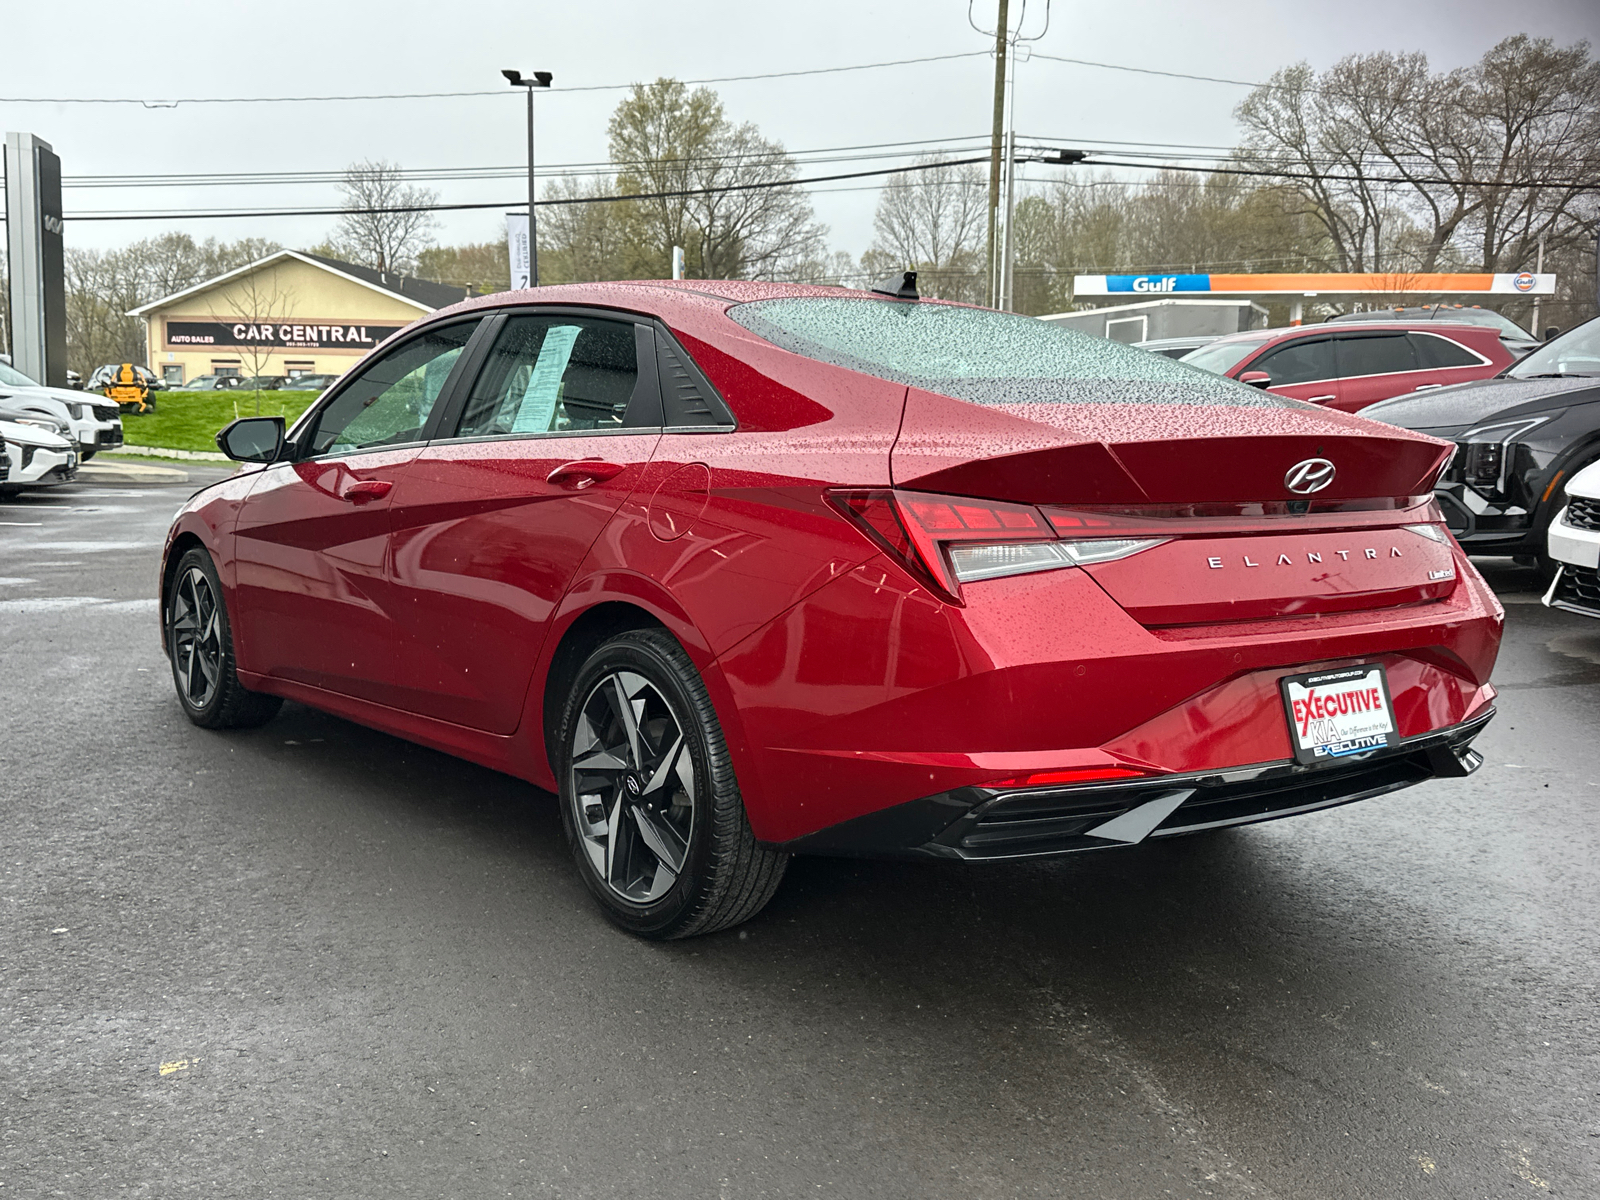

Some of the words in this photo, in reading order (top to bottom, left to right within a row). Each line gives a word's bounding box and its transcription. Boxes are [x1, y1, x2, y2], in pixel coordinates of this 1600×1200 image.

[1132, 277, 1177, 292] Gulf
[191, 336, 214, 344] SALES
[232, 324, 274, 341] CAR
[278, 324, 373, 342] CENTRAL
[1207, 546, 1402, 569] ELANTRA
[1428, 568, 1454, 580] Limited
[560, 684, 578, 742] KUMHO
[1292, 687, 1382, 739] EXECUTIVE
[1310, 718, 1342, 744] KIA
[1349, 726, 1368, 737] Difference
[1313, 734, 1388, 757] EXECUTIVE
